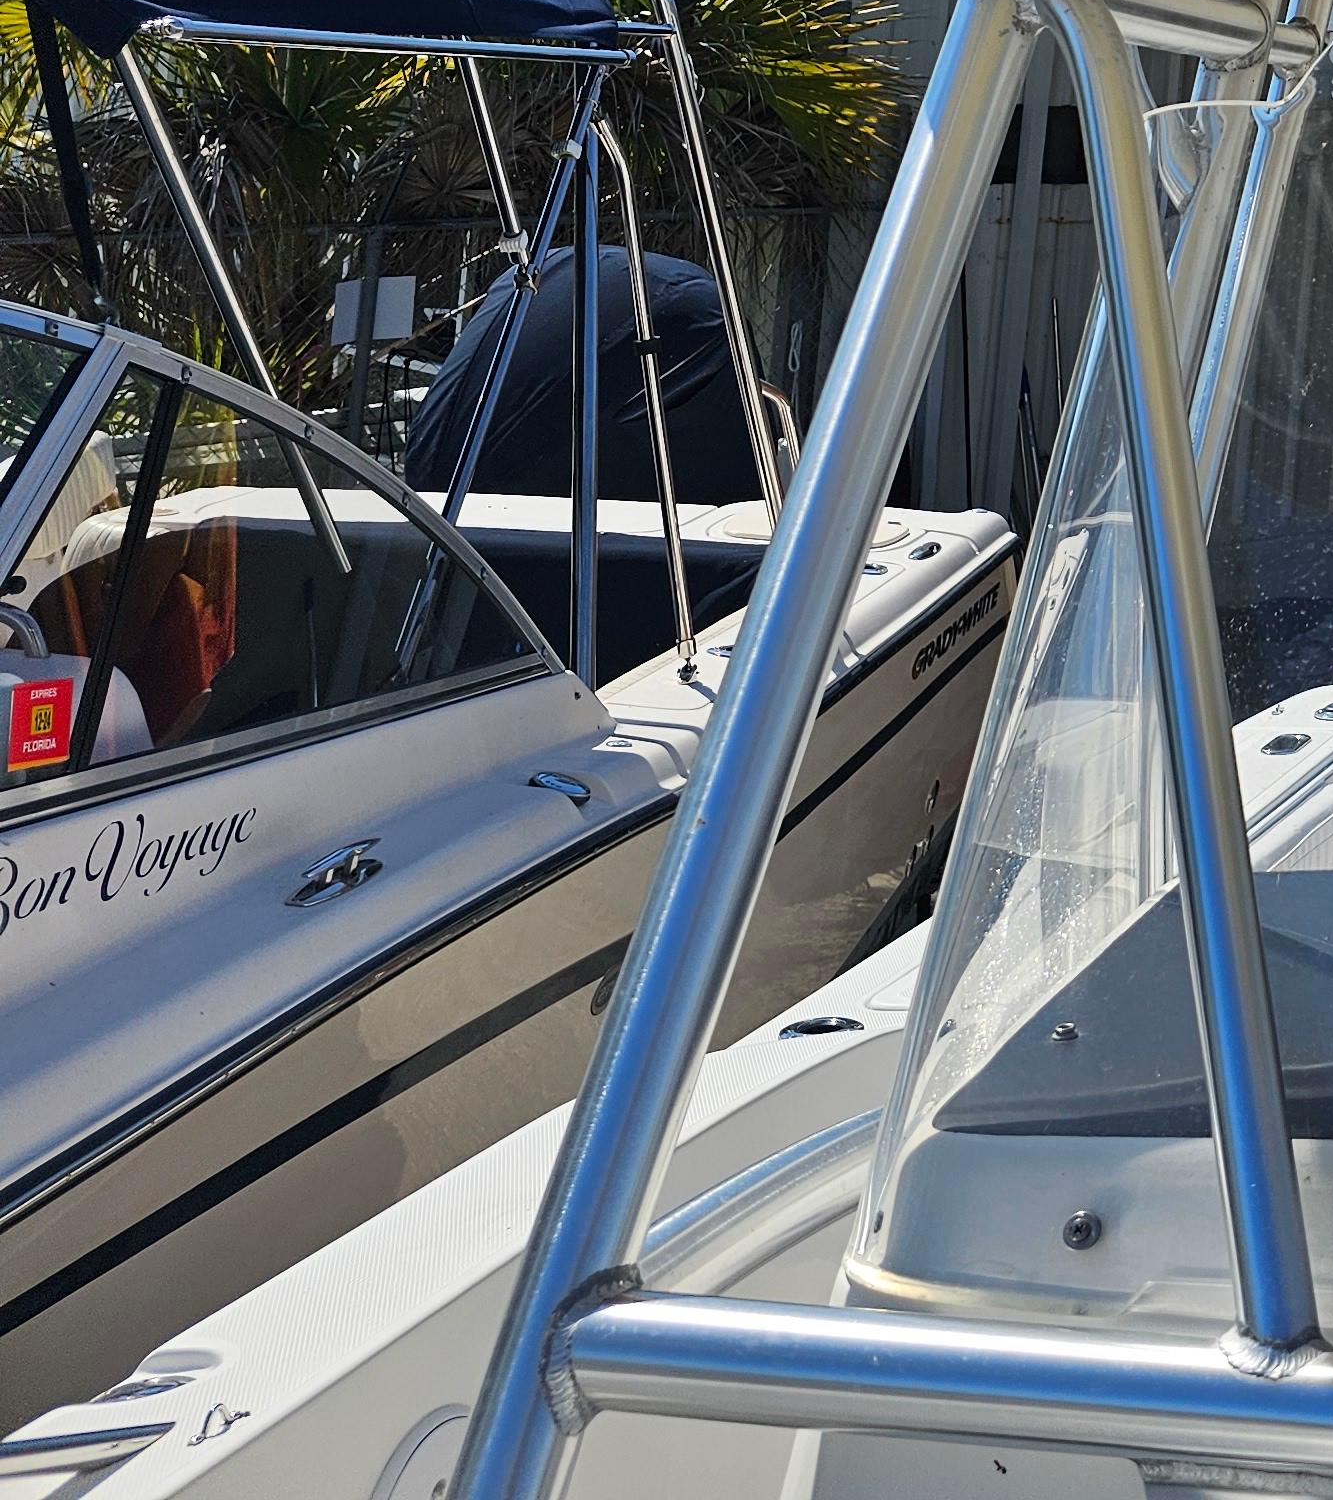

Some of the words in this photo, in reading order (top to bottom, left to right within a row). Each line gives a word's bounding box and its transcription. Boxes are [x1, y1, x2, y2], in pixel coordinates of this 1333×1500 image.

[30, 687, 58, 700] EXPIRES
[22, 737, 57, 753] FLORIDA
[85, 807, 257, 902] Voyage
